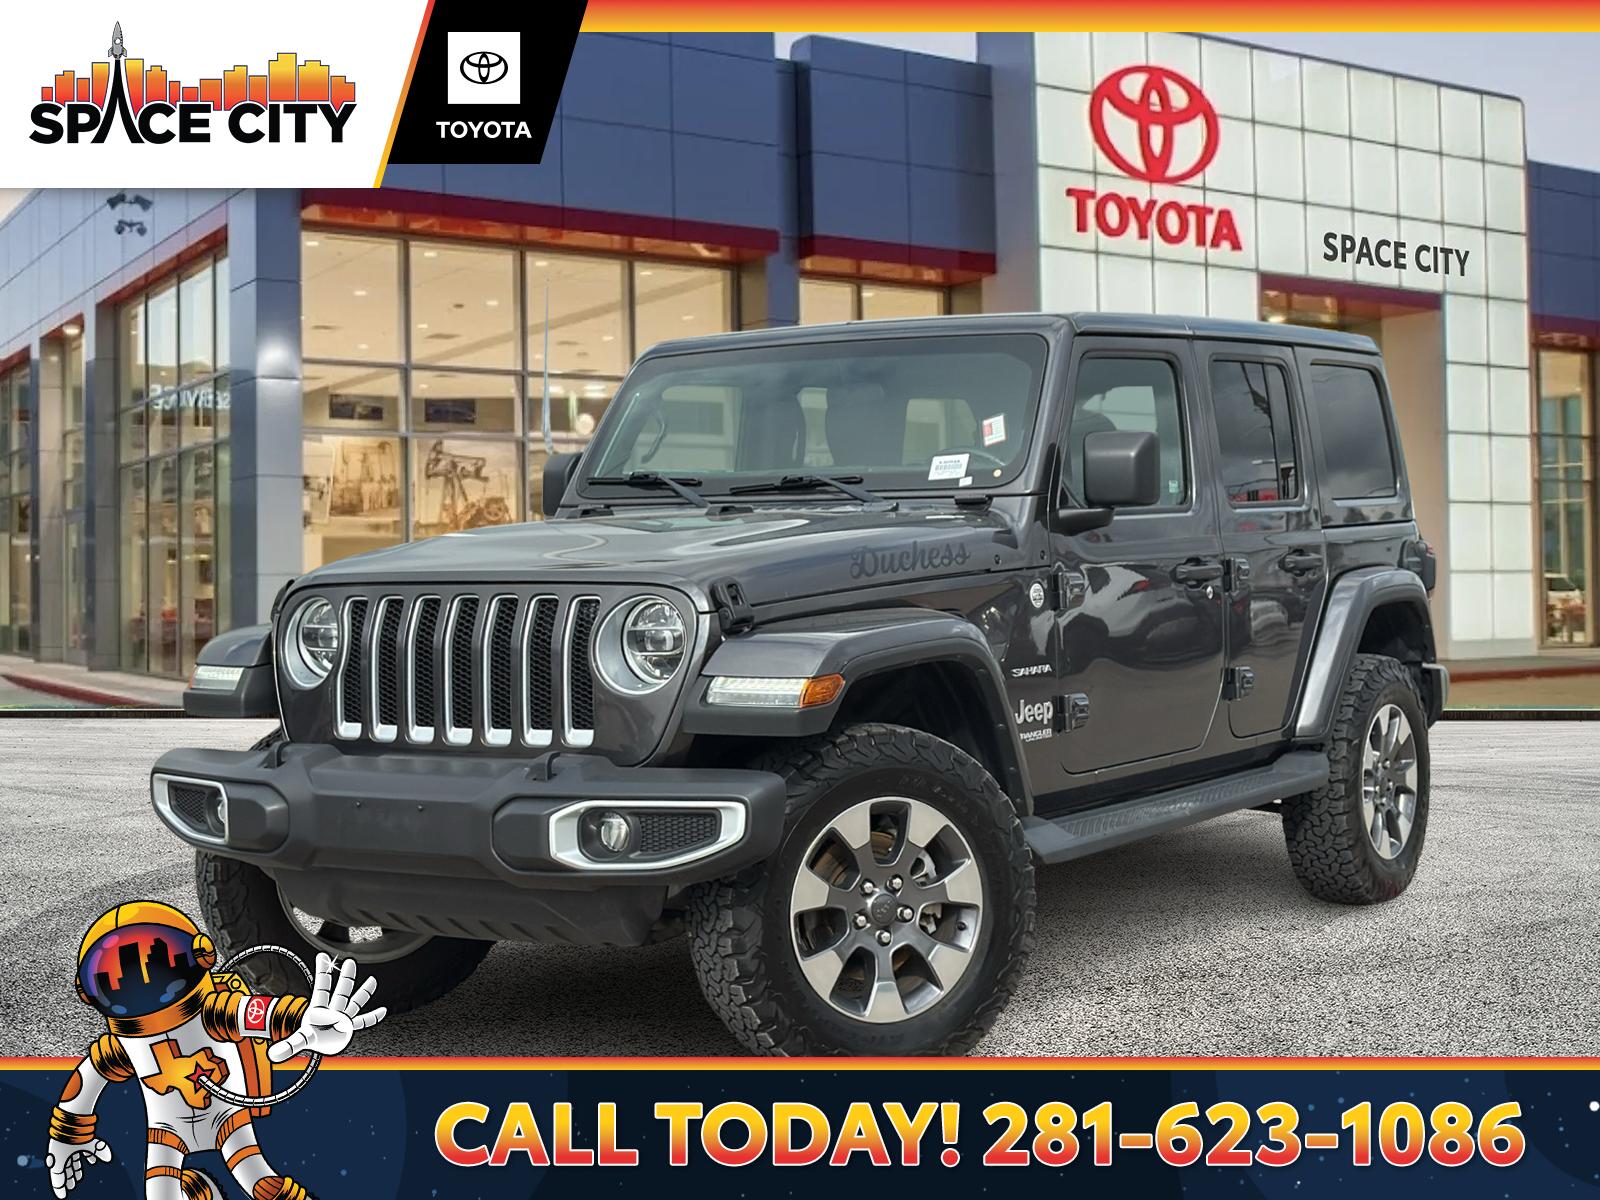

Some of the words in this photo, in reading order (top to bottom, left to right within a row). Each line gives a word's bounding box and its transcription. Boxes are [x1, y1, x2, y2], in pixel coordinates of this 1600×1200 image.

[1065, 187, 1243, 251] TOYOTA
[1323, 232, 1407, 270] SPACE
[1414, 244, 1470, 277] CITY
[849, 540, 971, 579] Duchess
[1011, 664, 1052, 678] SAHARA
[1014, 699, 1054, 725] Jeep
